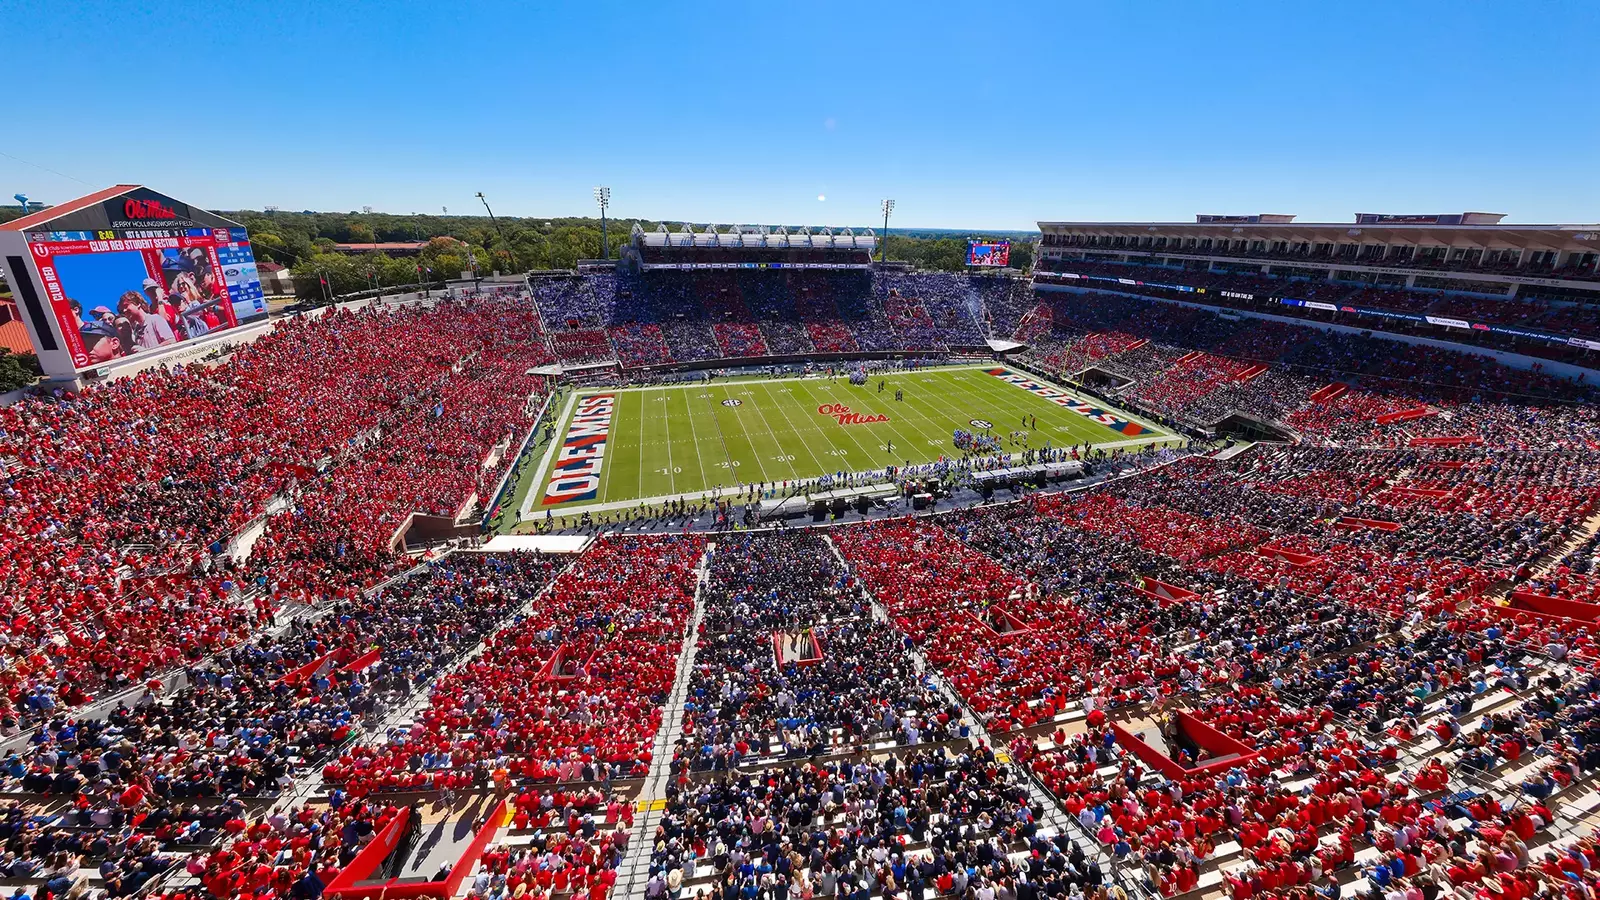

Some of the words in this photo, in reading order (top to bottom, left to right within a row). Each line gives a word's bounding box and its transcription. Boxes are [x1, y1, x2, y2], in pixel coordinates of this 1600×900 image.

[125, 199, 146, 219] Ole
[143, 199, 176, 219] Miss
[133, 220, 178, 228] HOLLINGSWORTH
[98, 231, 115, 240] 8:49
[89, 240, 110, 252] CLUB
[109, 239, 125, 251] RED
[125, 238, 153, 250] STUDENT
[153, 237, 179, 248] SECTION
[42, 266, 57, 281] RED
[48, 282, 64, 301] CLUB
[158, 355, 174, 365] JERRY
[175, 343, 218, 360] HOLLINGSWORTH
[818, 403, 851, 415] Ole
[566, 397, 615, 438] MISS
[832, 412, 891, 425] Miss
[721, 460, 741, 469] 20
[777, 454, 796, 462] 30
[545, 443, 606, 496] OLE
[661, 467, 682, 476] 10
[1168, 882, 1177, 893] 10
